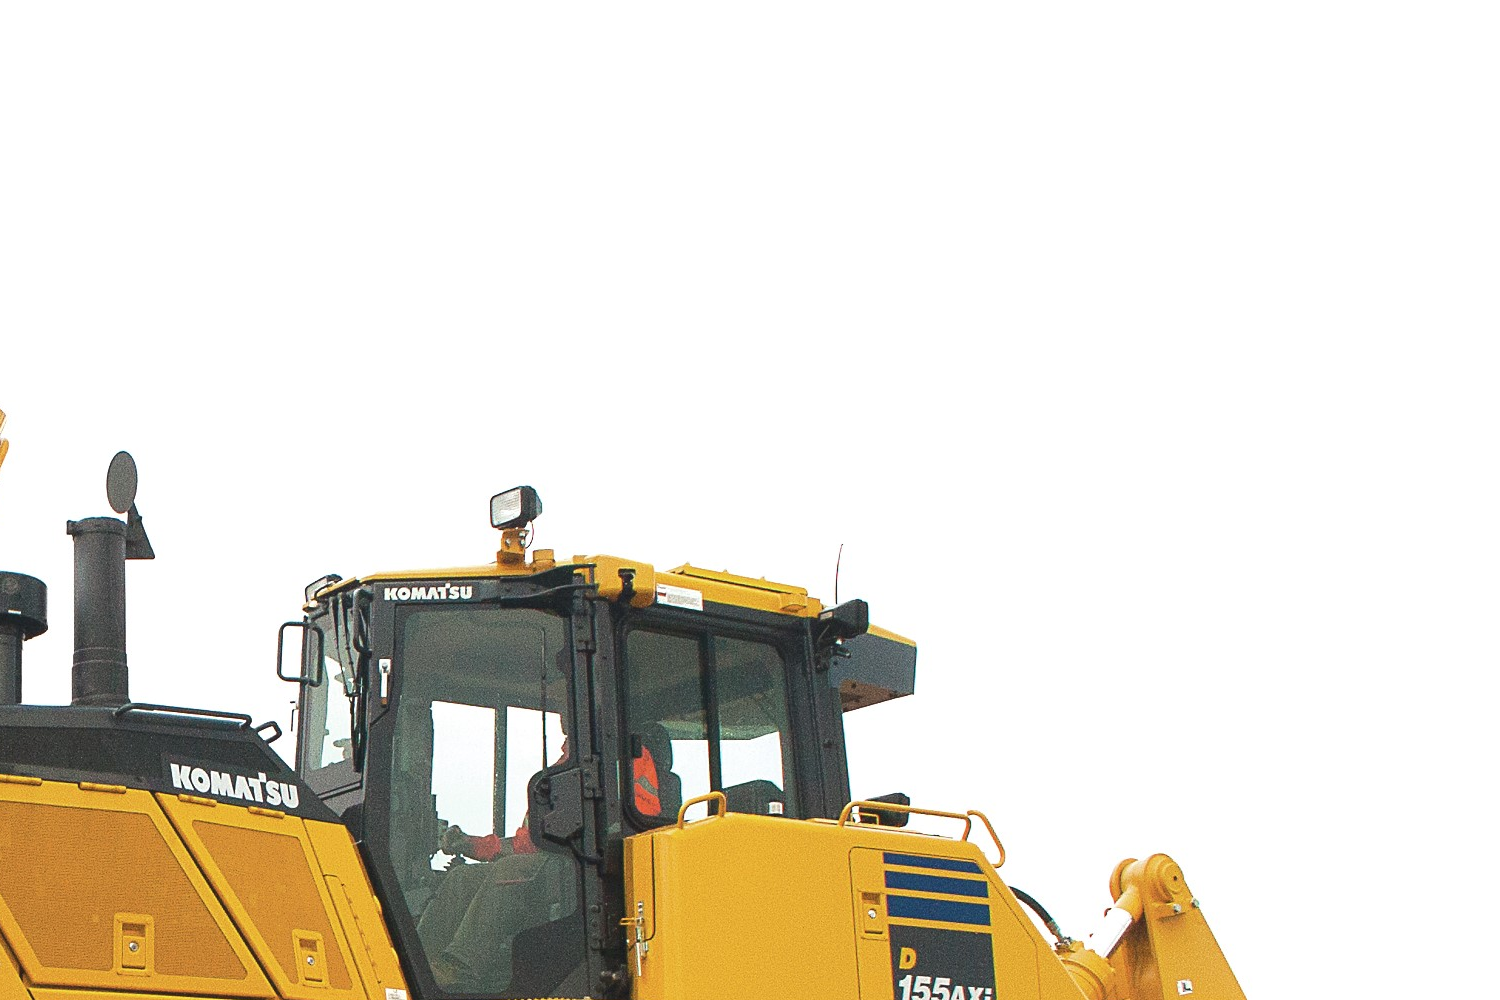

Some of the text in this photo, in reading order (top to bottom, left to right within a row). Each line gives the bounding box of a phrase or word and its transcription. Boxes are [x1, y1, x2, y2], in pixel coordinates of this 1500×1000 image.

[384, 583, 473, 600] KOMATSU
[170, 763, 299, 809] KOMATSU
[899, 947, 917, 970] D
